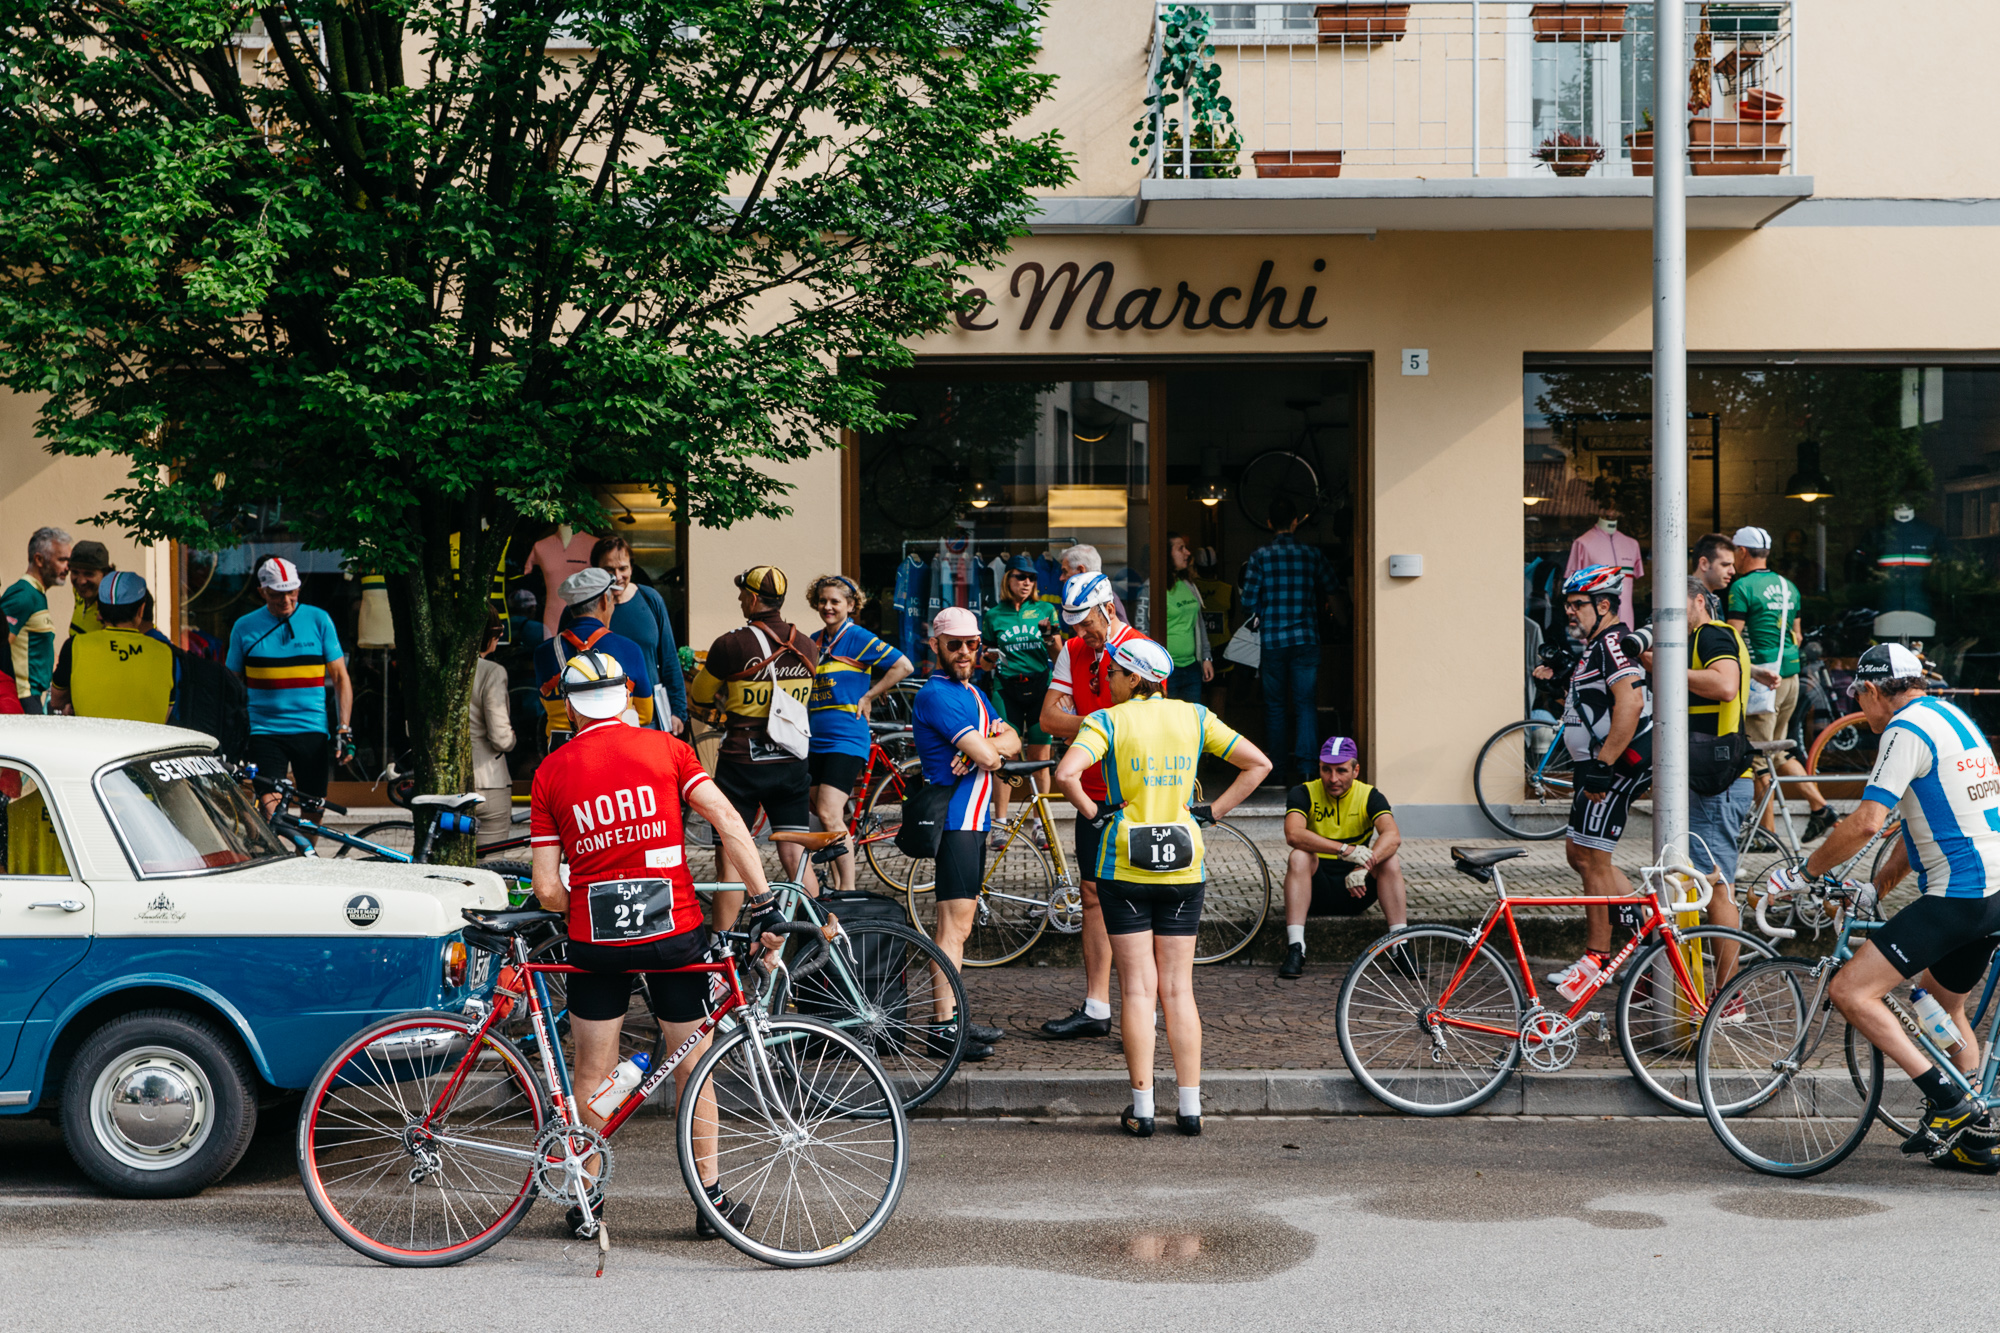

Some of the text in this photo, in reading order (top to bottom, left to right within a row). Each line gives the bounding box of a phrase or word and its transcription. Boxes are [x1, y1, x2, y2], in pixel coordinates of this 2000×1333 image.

[1010, 258, 1328, 331] Marchi
[1410, 354, 1420, 370] 5
[110, 640, 143, 662] EDM
[743, 687, 809, 705] DUOP
[1165, 755, 1192, 771] LIDO
[1143, 775, 1183, 787] VENEZIA
[572, 785, 657, 834] NORD
[576, 820, 667, 854] CONFEZIONI
[1152, 828, 1171, 841] EDM
[1151, 843, 1176, 863] 18
[617, 884, 642, 900] EDM
[614, 903, 647, 928] 27
[1620, 914, 1634, 924] 18
[1593, 943, 1634, 988] PINARELLO
[1883, 995, 1917, 1032] LNAGO
[645, 1034, 699, 1090] SANVIDO
